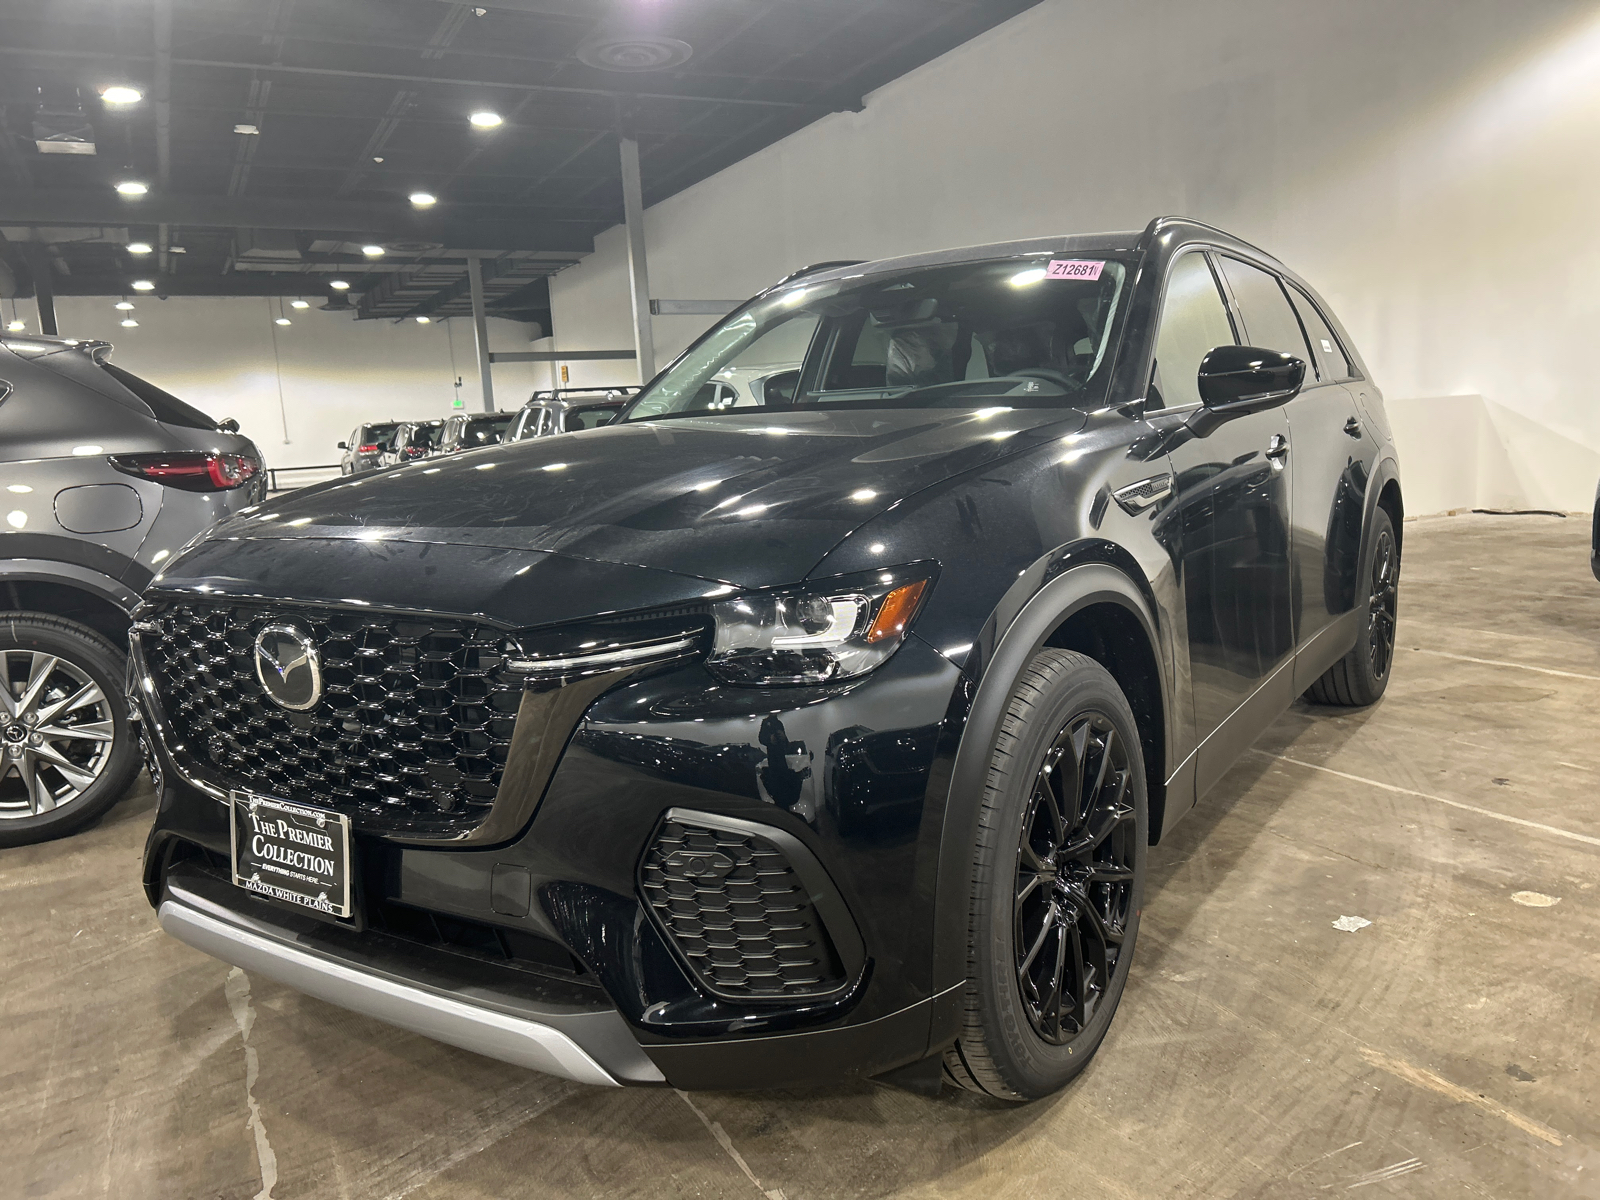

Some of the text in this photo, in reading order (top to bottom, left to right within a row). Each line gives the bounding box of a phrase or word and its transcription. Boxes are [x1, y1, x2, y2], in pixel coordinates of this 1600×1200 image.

[1052, 263, 1095, 276] Z12681
[249, 813, 334, 852] THE PREMIER
[252, 835, 335, 877] COLLECTION
[261, 863, 290, 877] EVERYTHING
[289, 870, 306, 881] STARTS
[245, 881, 334, 912] MAZDA WHITE PLAINS
